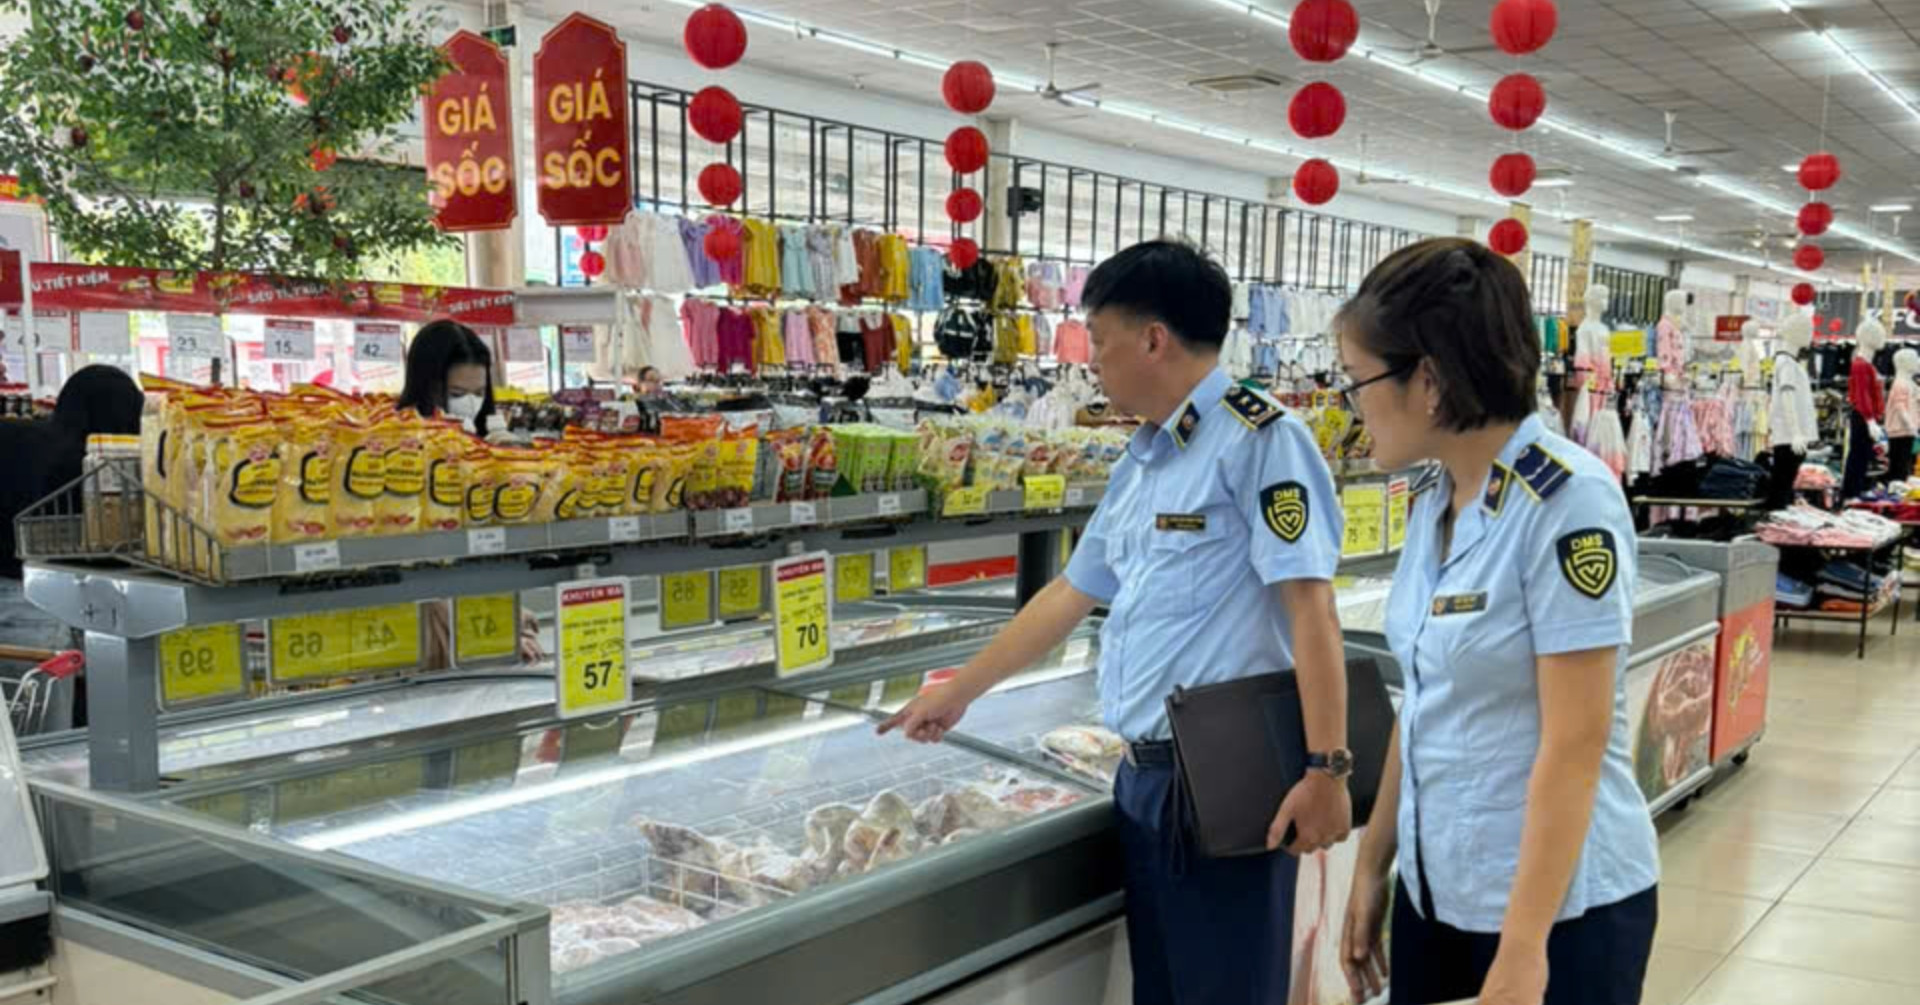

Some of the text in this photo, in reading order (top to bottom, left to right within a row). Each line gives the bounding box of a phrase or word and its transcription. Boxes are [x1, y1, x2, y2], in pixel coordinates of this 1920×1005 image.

[438, 81, 496, 135] GIÁ
[549, 68, 612, 124] GIÁ
[434, 141, 506, 199] SỐC
[543, 130, 621, 190] SỐC
[1273, 488, 1300, 502] DMS
[1571, 533, 1603, 550] DMS
[797, 622, 819, 649] 70
[584, 660, 613, 690] 57
